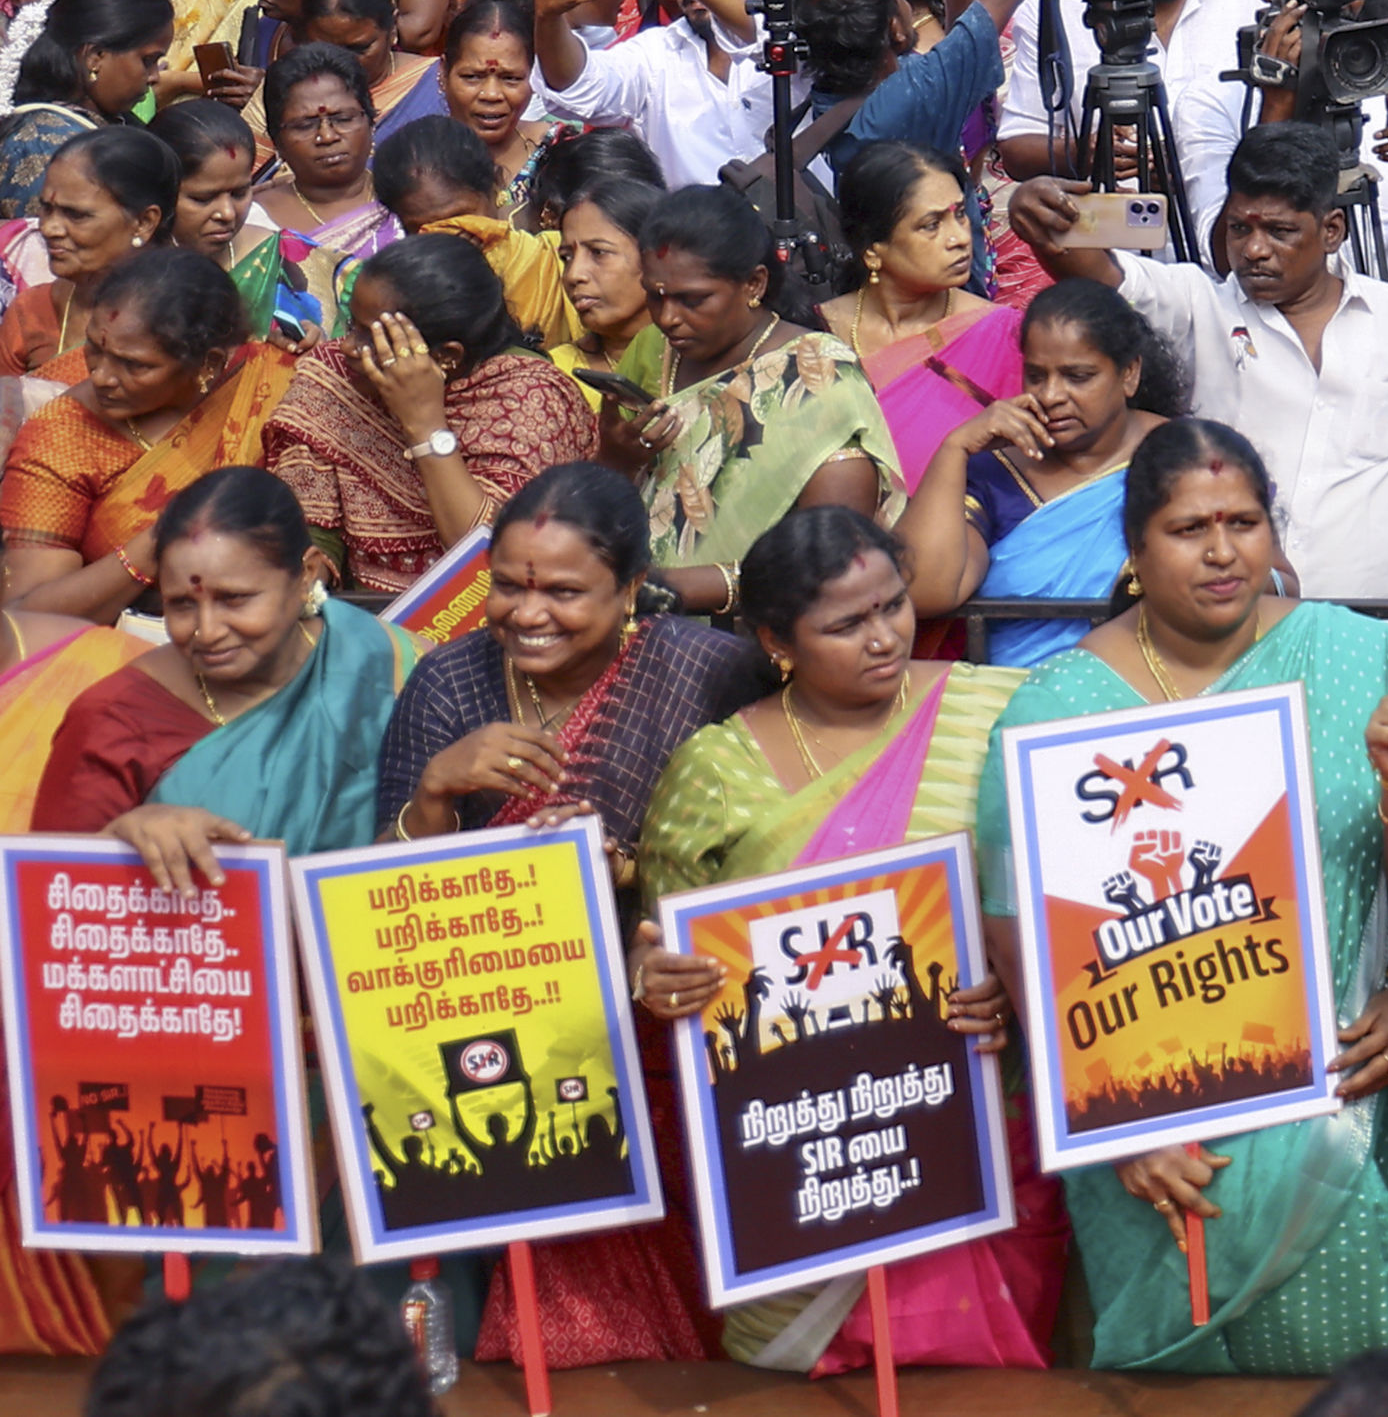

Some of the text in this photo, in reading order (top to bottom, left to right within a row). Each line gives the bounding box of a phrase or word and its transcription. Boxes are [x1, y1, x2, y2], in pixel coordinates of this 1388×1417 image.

[368, 864, 537, 915] பறிக்காதே..!
[51, 913, 239, 963] சிதைக்காதே..
[375, 903, 544, 954] பறிக்காதே..!
[1098, 882, 1257, 962] Our Vote
[43, 956, 251, 997] மக்களாட்சியை
[347, 938, 586, 994] வாக்குரிமையை
[59, 993, 242, 1042] சிதைக்காதே!
[386, 980, 562, 1032] பறிக்காதே..!!
[1066, 934, 1290, 1051] Our Rights
[741, 1061, 953, 1148] நிறுத்து நிறுத்து
[802, 1125, 906, 1175] SIR யை
[797, 1158, 920, 1223] நிறுத்து..!
